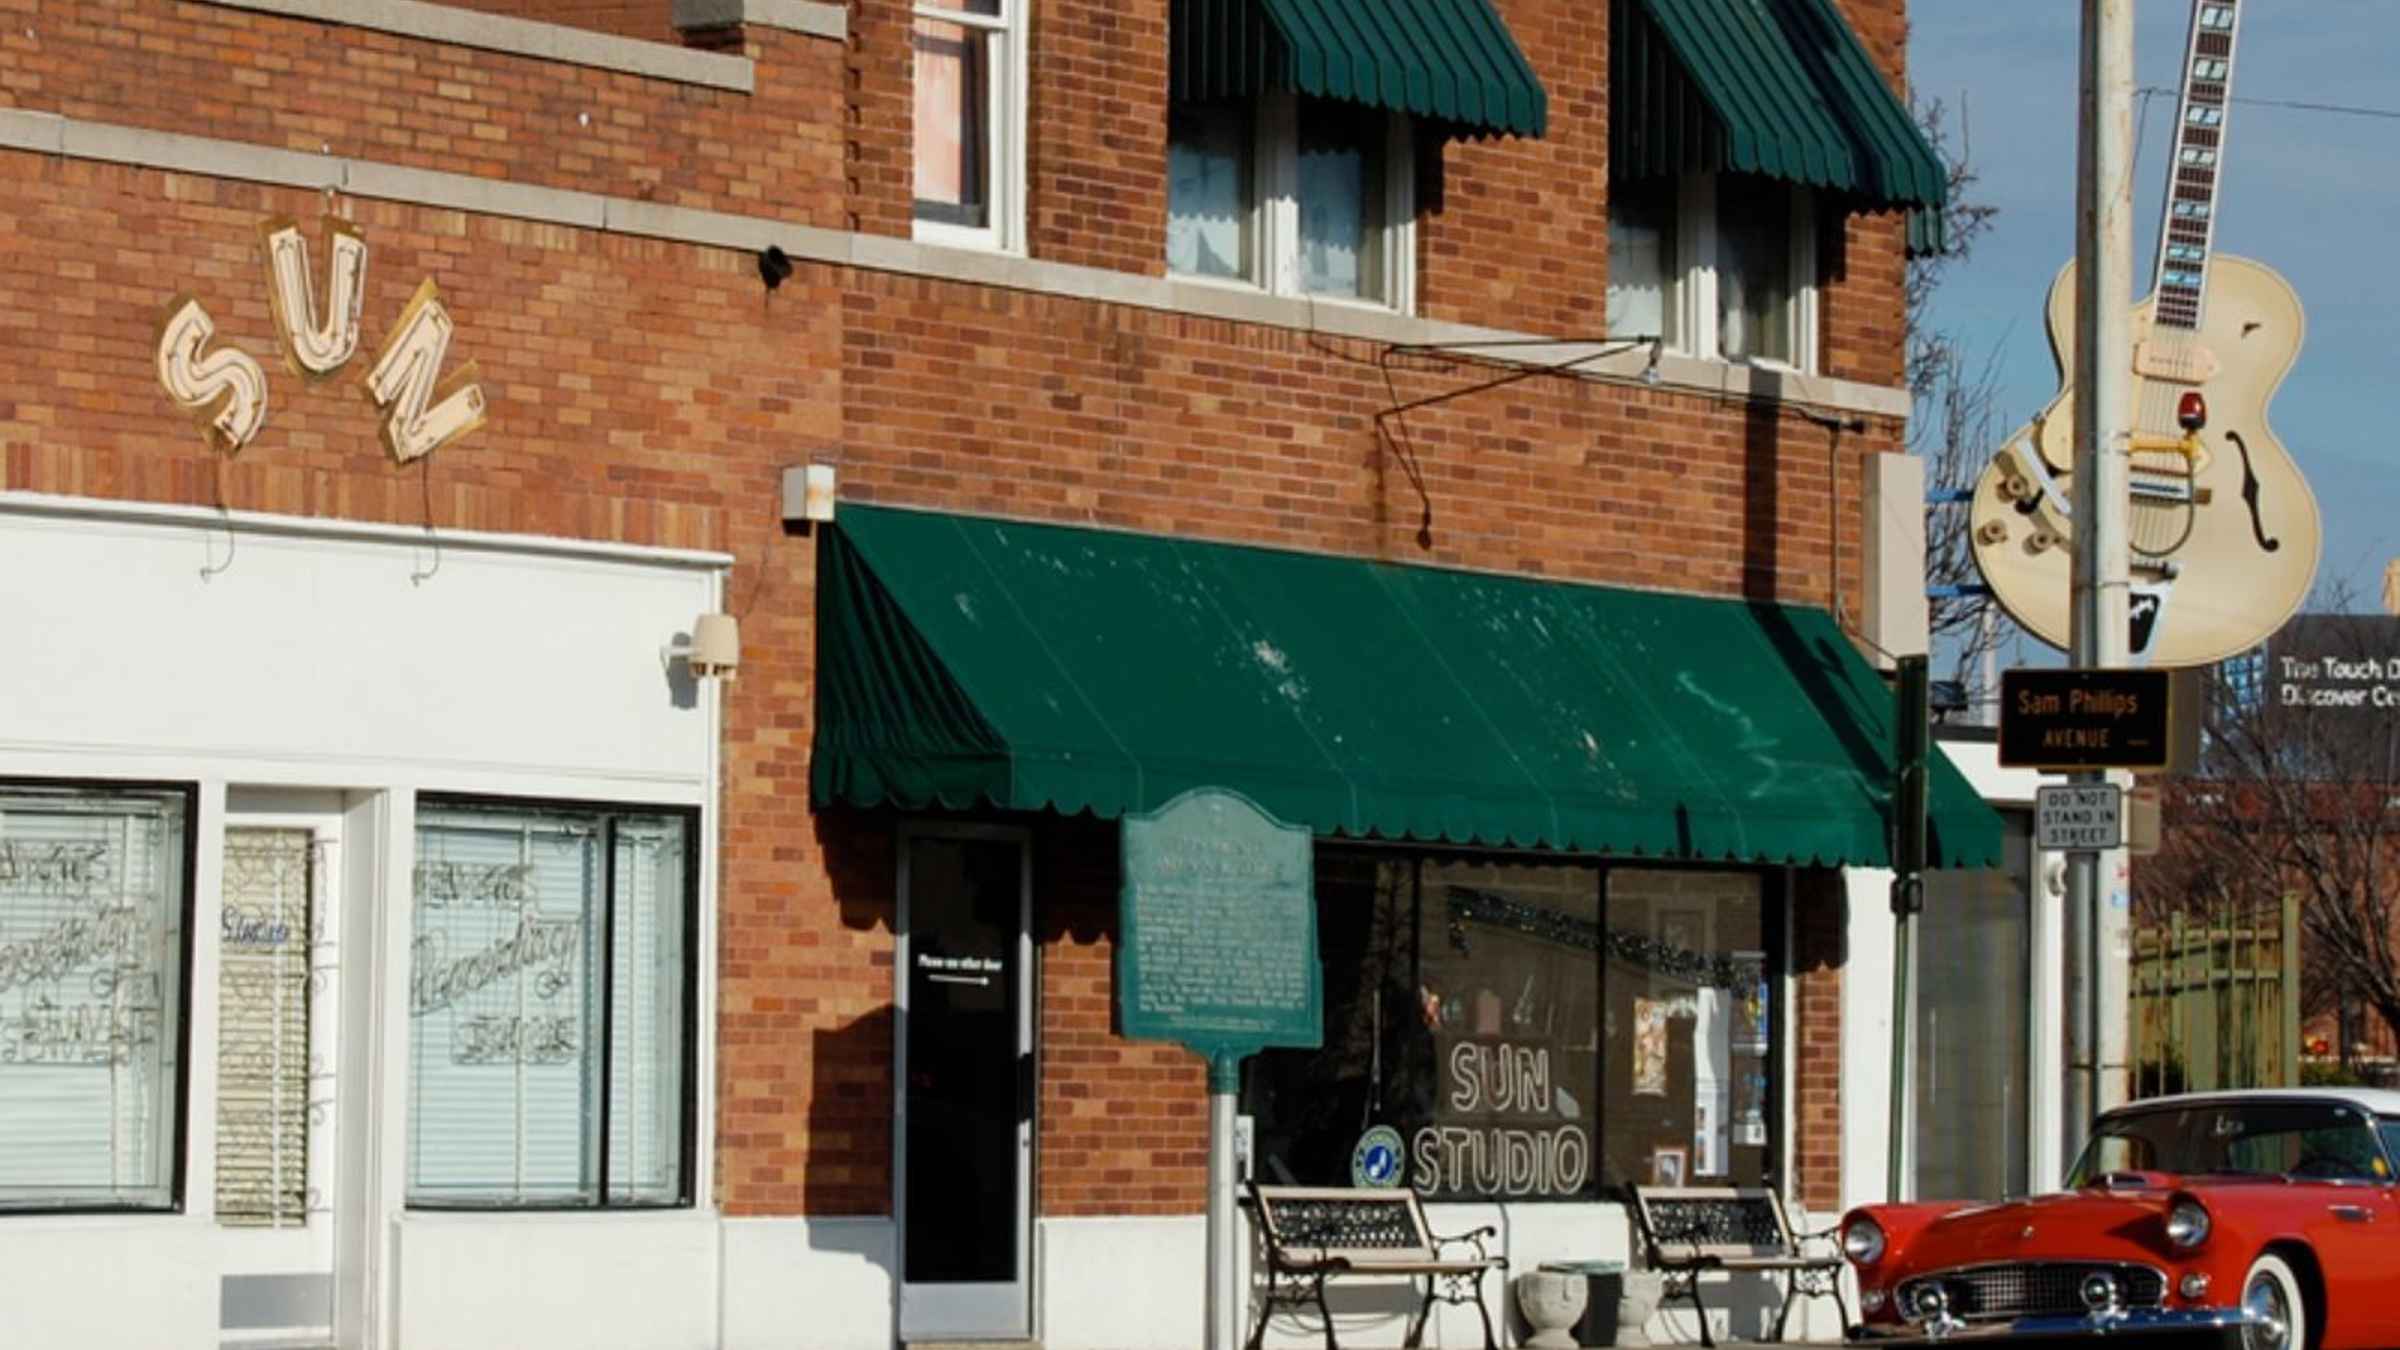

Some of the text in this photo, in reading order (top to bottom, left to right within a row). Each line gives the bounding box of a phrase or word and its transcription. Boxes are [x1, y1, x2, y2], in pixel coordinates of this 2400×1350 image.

[157, 219, 487, 465] SUN
[2321, 656, 2383, 679] Touch
[2018, 688, 2138, 719] Sam Phillips
[2042, 727, 2111, 748] AVENUE
[2048, 791, 2108, 806] DO NOT
[2042, 810, 2116, 825] STAND IN
[2050, 828, 2108, 843] STREET
[1451, 1041, 1550, 1112] SUN
[1413, 1124, 1588, 1196] STUDIO
